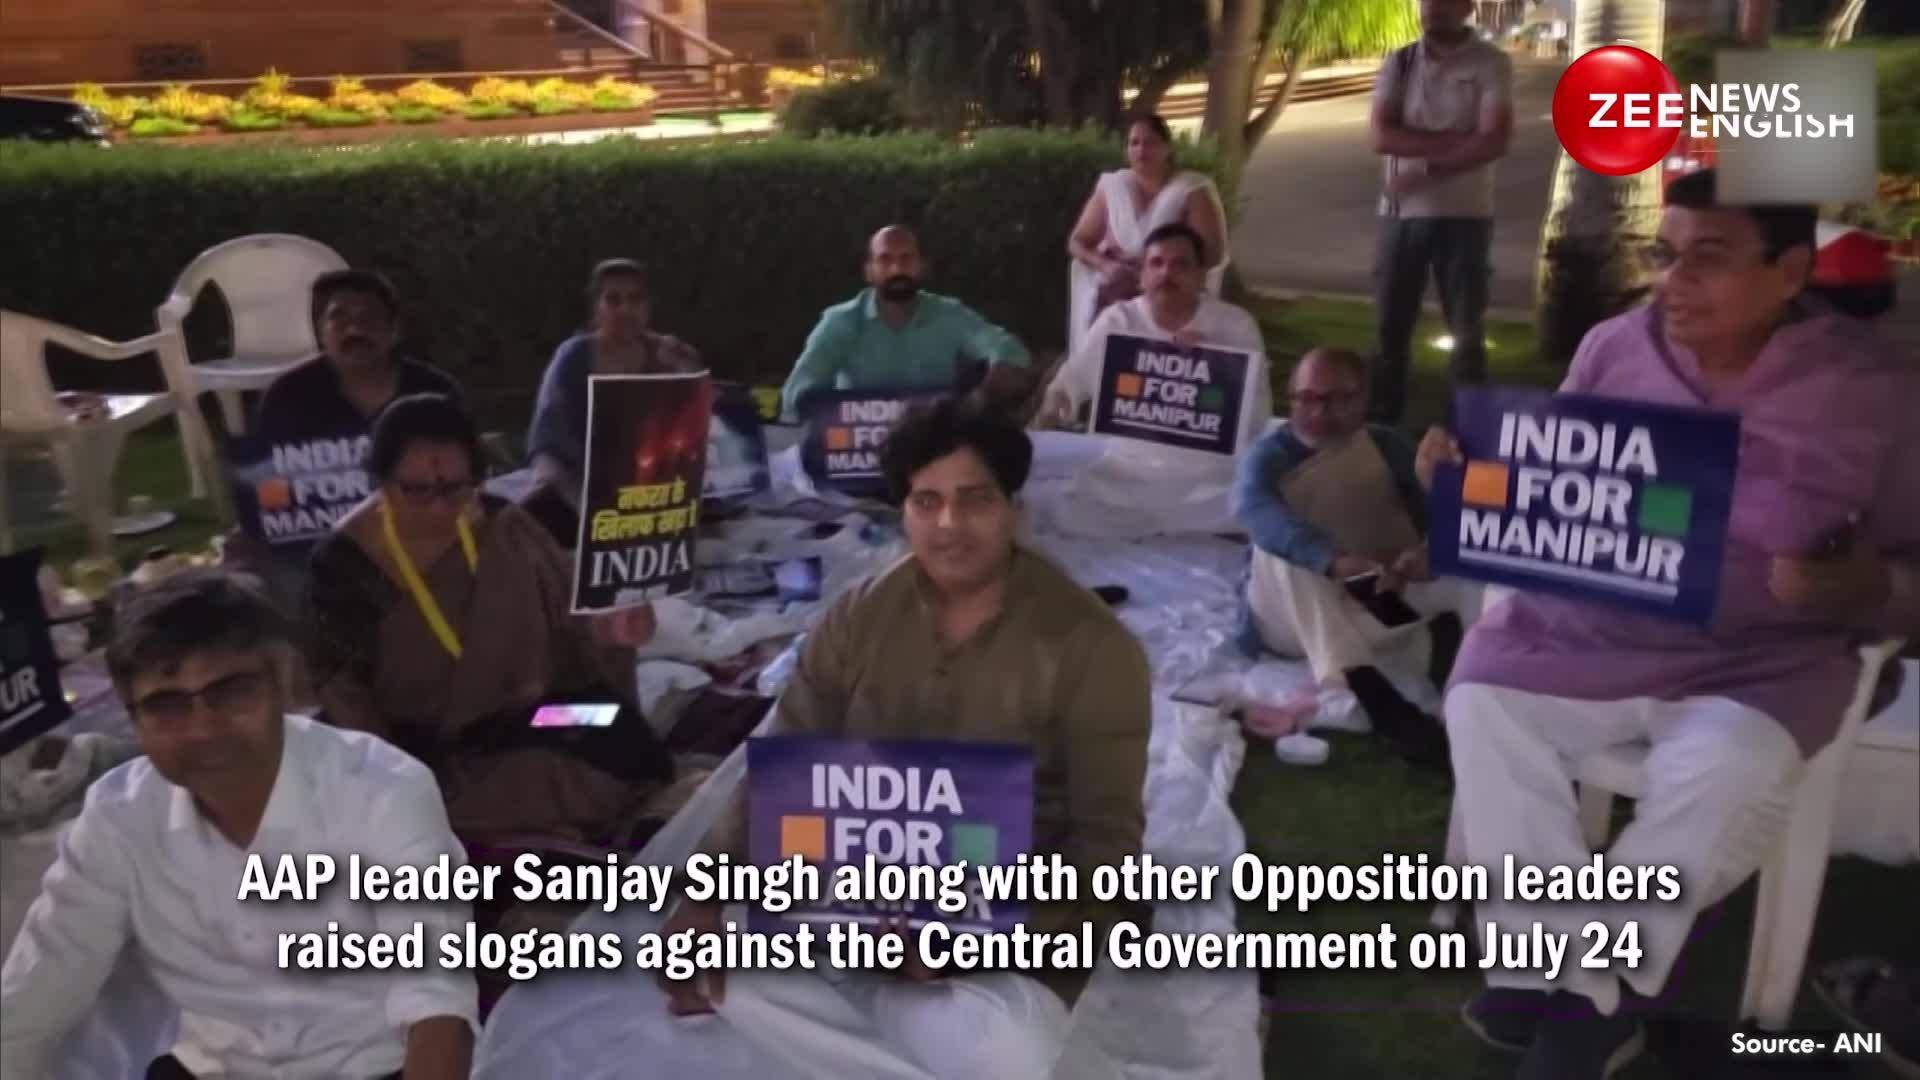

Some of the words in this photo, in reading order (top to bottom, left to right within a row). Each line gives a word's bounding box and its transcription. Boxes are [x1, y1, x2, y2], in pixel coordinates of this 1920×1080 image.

[1137, 351, 1210, 383] INDIA
[1113, 398, 1222, 432] MANIPUR
[1143, 377, 1198, 407] FOR
[1498, 412, 1657, 477] INDIA
[1516, 466, 1633, 526] FOR
[590, 540, 690, 587] INDIA
[1459, 508, 1686, 582] MANIPUR
[812, 763, 964, 815] INDIA
[833, 817, 943, 866] FOR
